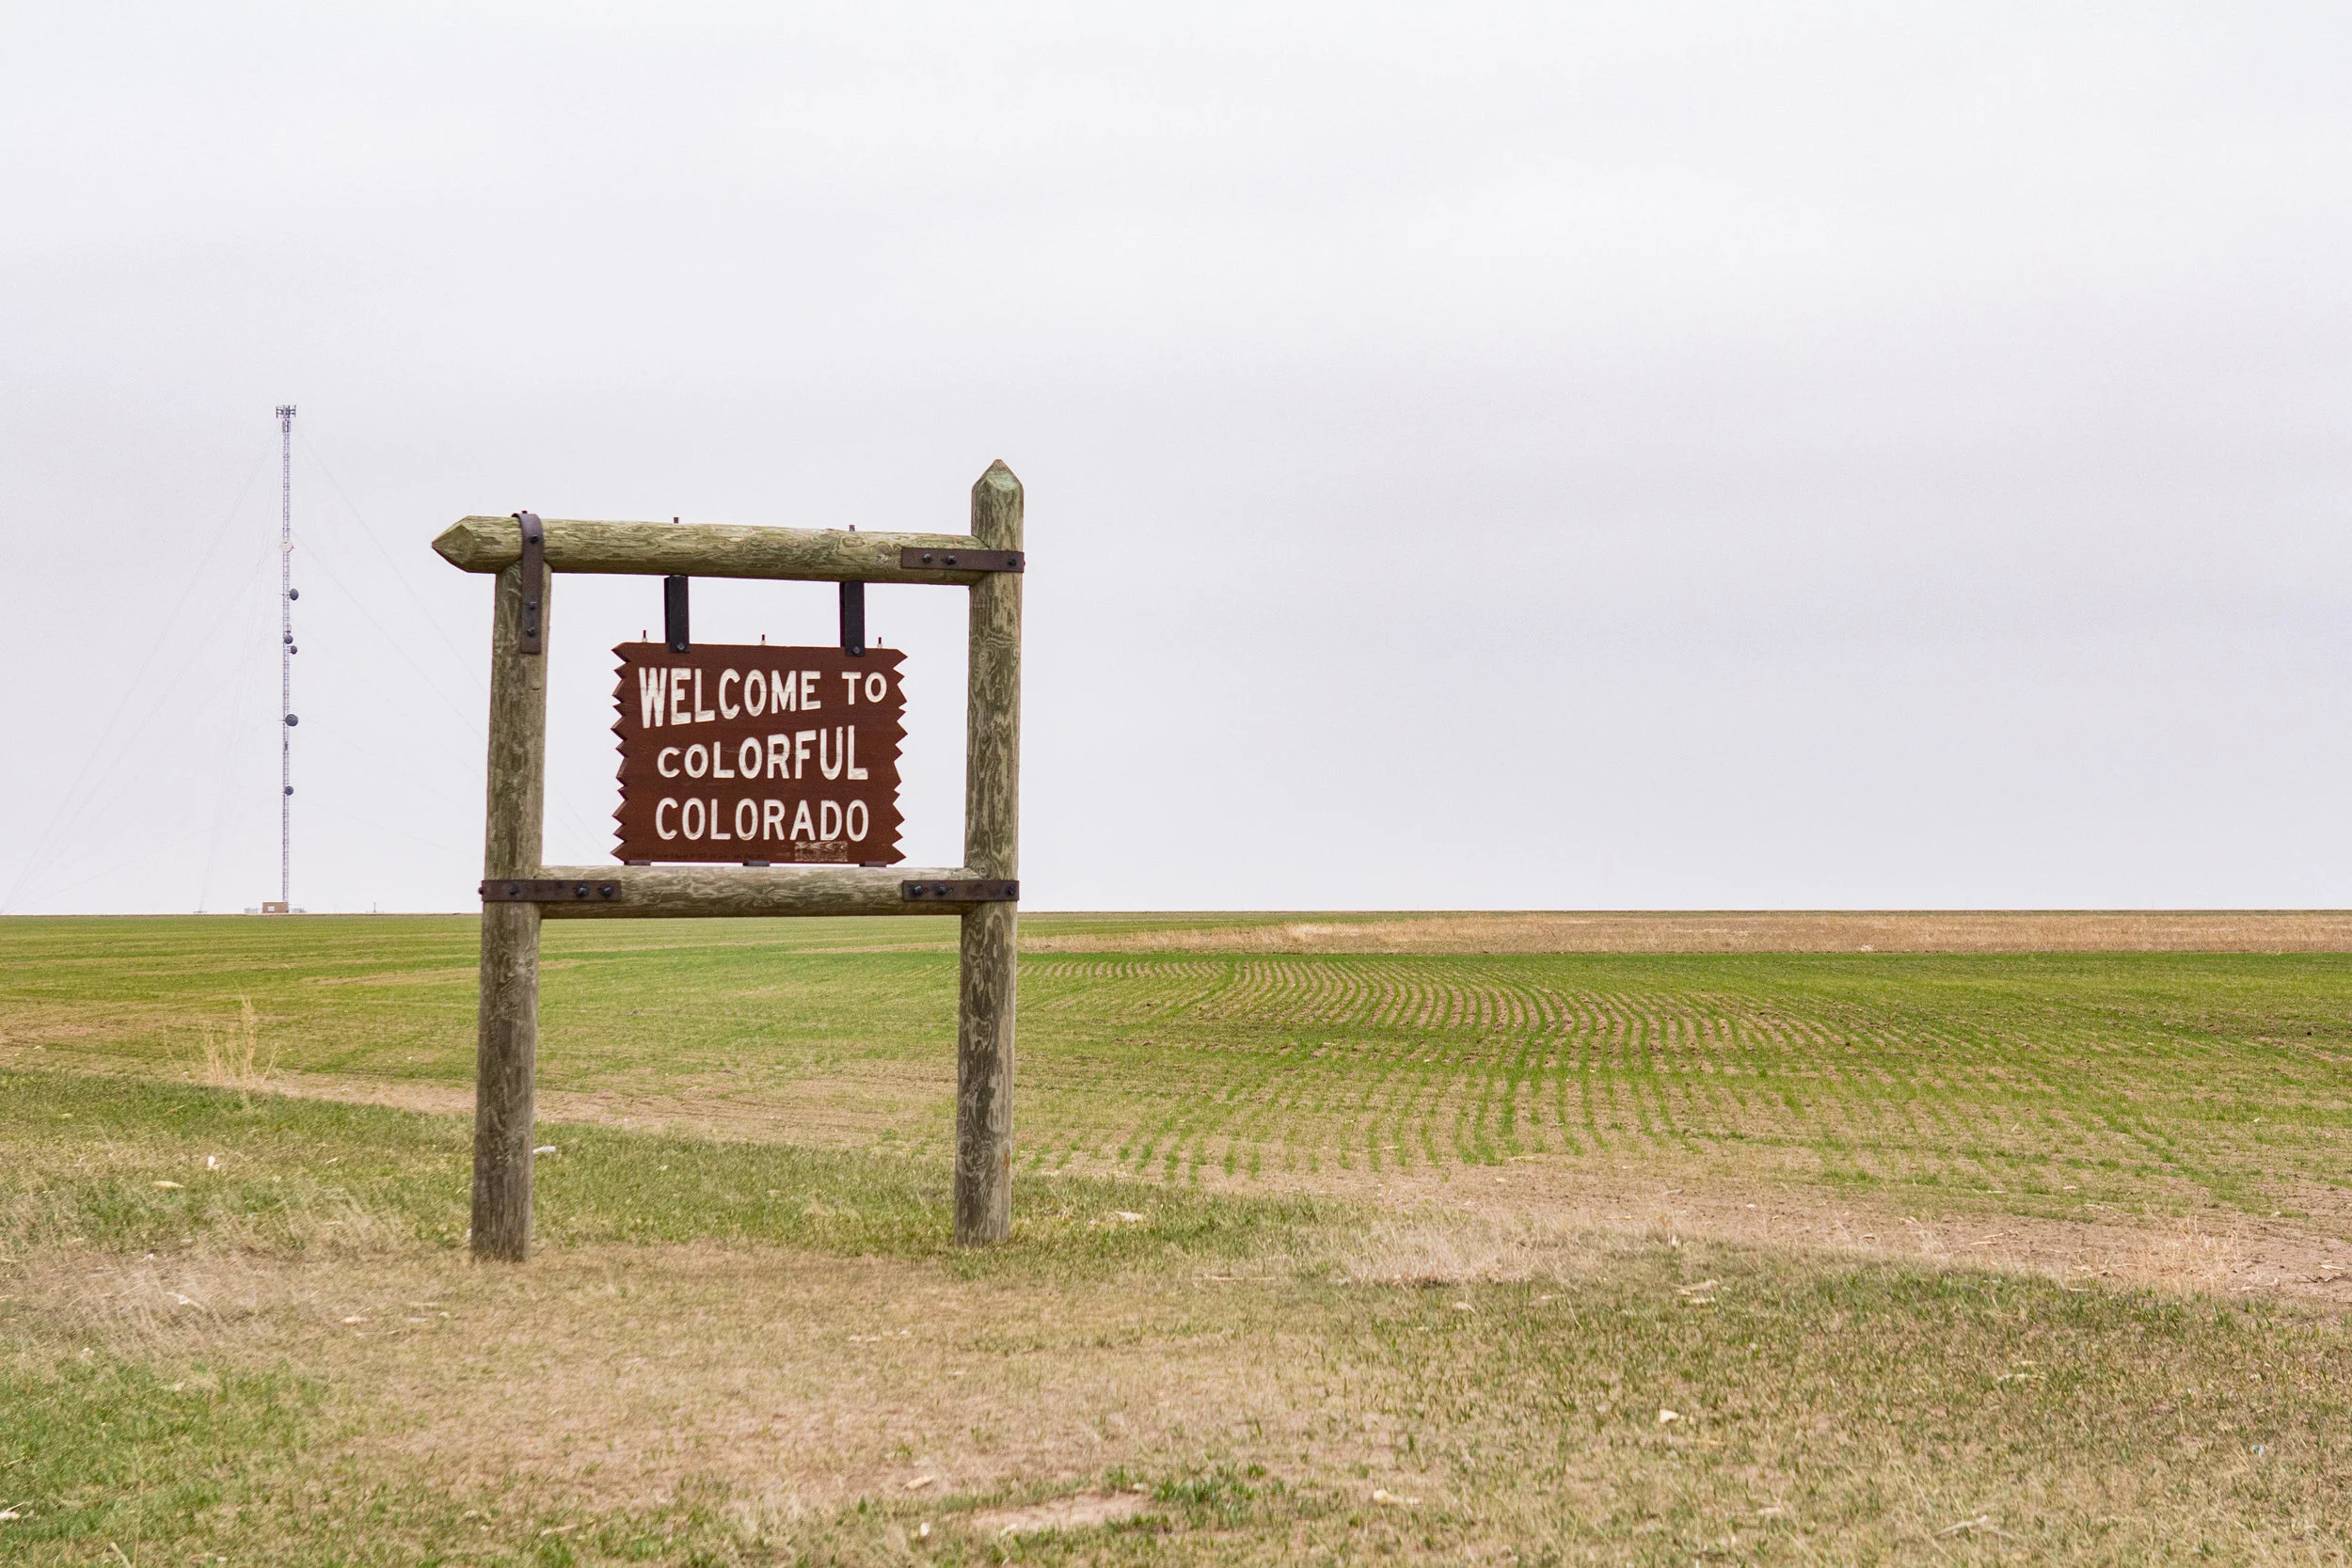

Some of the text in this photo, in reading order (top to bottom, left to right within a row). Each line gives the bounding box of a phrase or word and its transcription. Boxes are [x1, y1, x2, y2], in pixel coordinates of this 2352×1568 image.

[638, 667, 887, 729] WELCOME TO
[657, 724, 868, 781] COLORFUL
[655, 797, 869, 842] COLORADO
